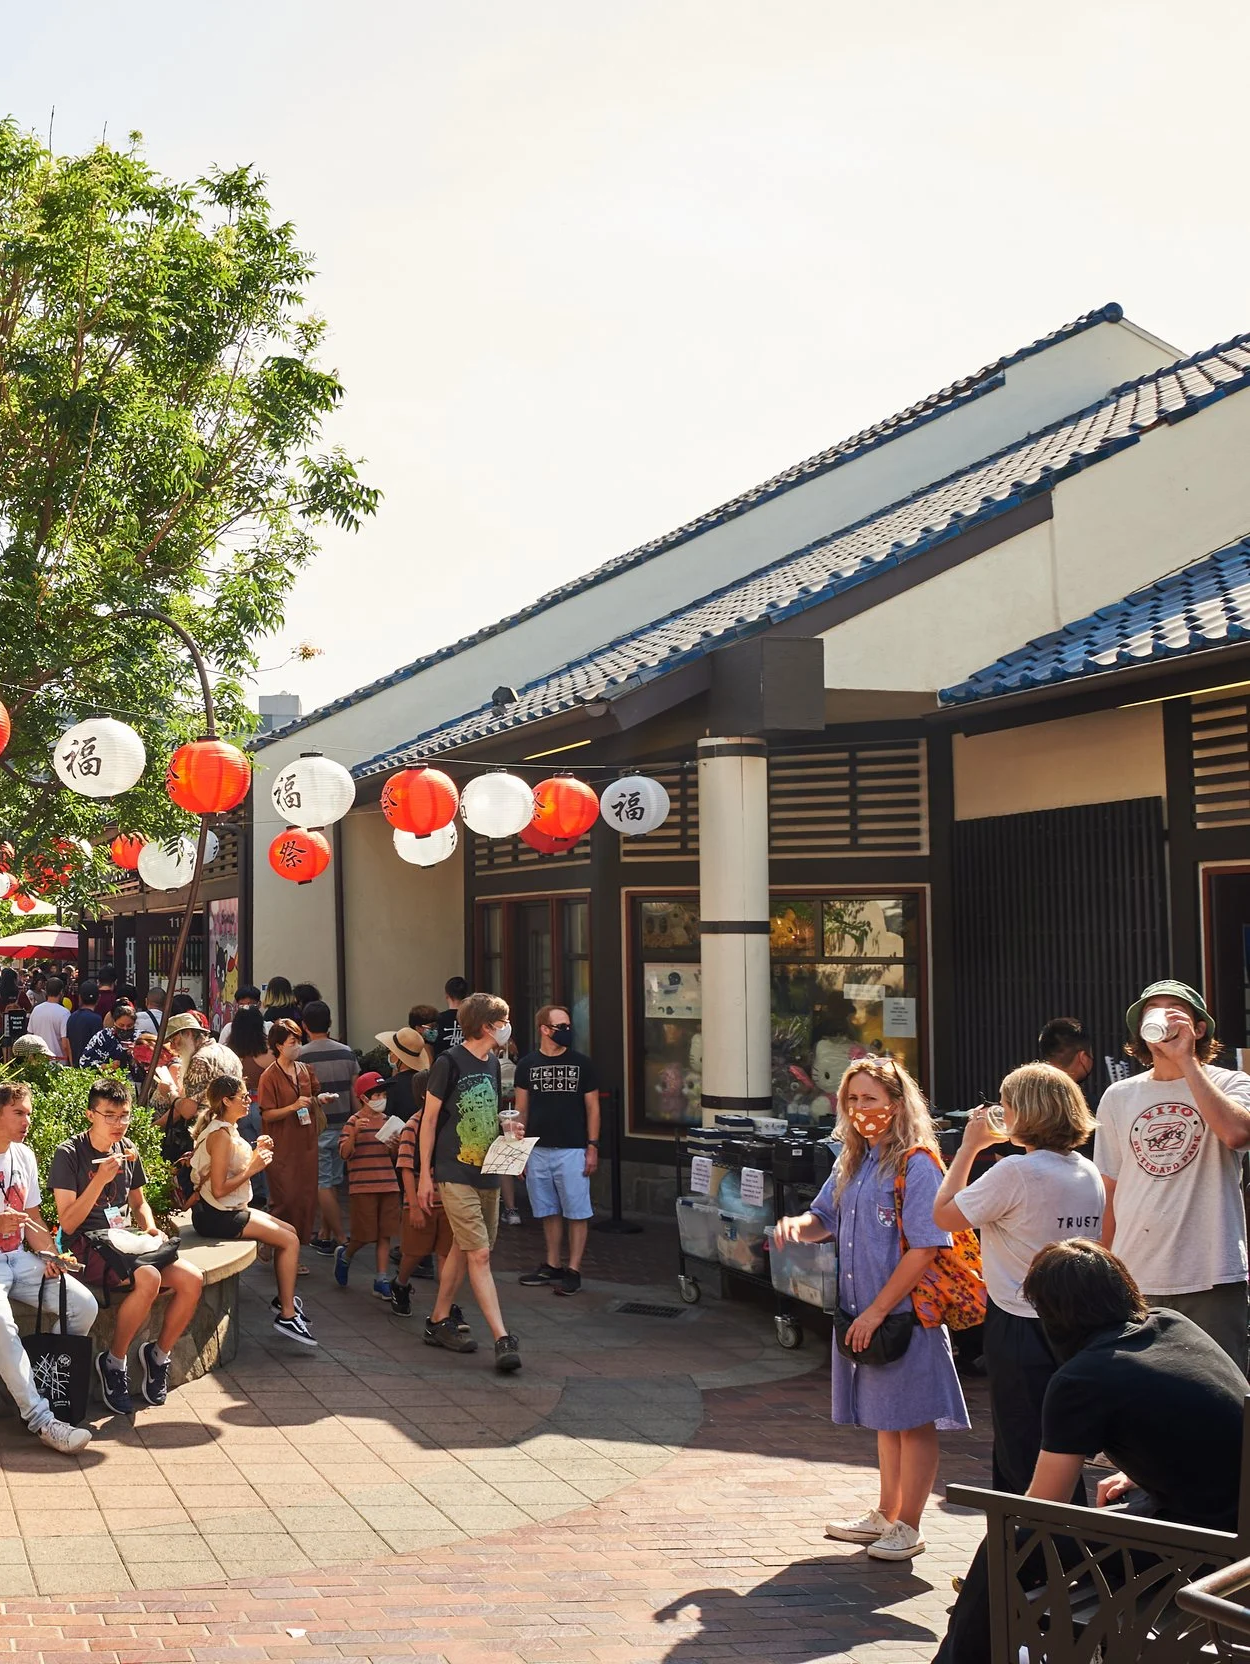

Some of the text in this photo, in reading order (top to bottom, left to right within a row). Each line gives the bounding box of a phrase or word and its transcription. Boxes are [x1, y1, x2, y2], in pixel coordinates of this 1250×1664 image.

[61, 736, 102, 780] 福
[273, 773, 302, 813] 福
[611, 791, 645, 823] 福
[279, 840, 308, 868] 祭
[168, 917, 184, 928] 11
[1141, 1105, 1194, 1120] VITO
[1057, 1216, 1100, 1229] TRUST
